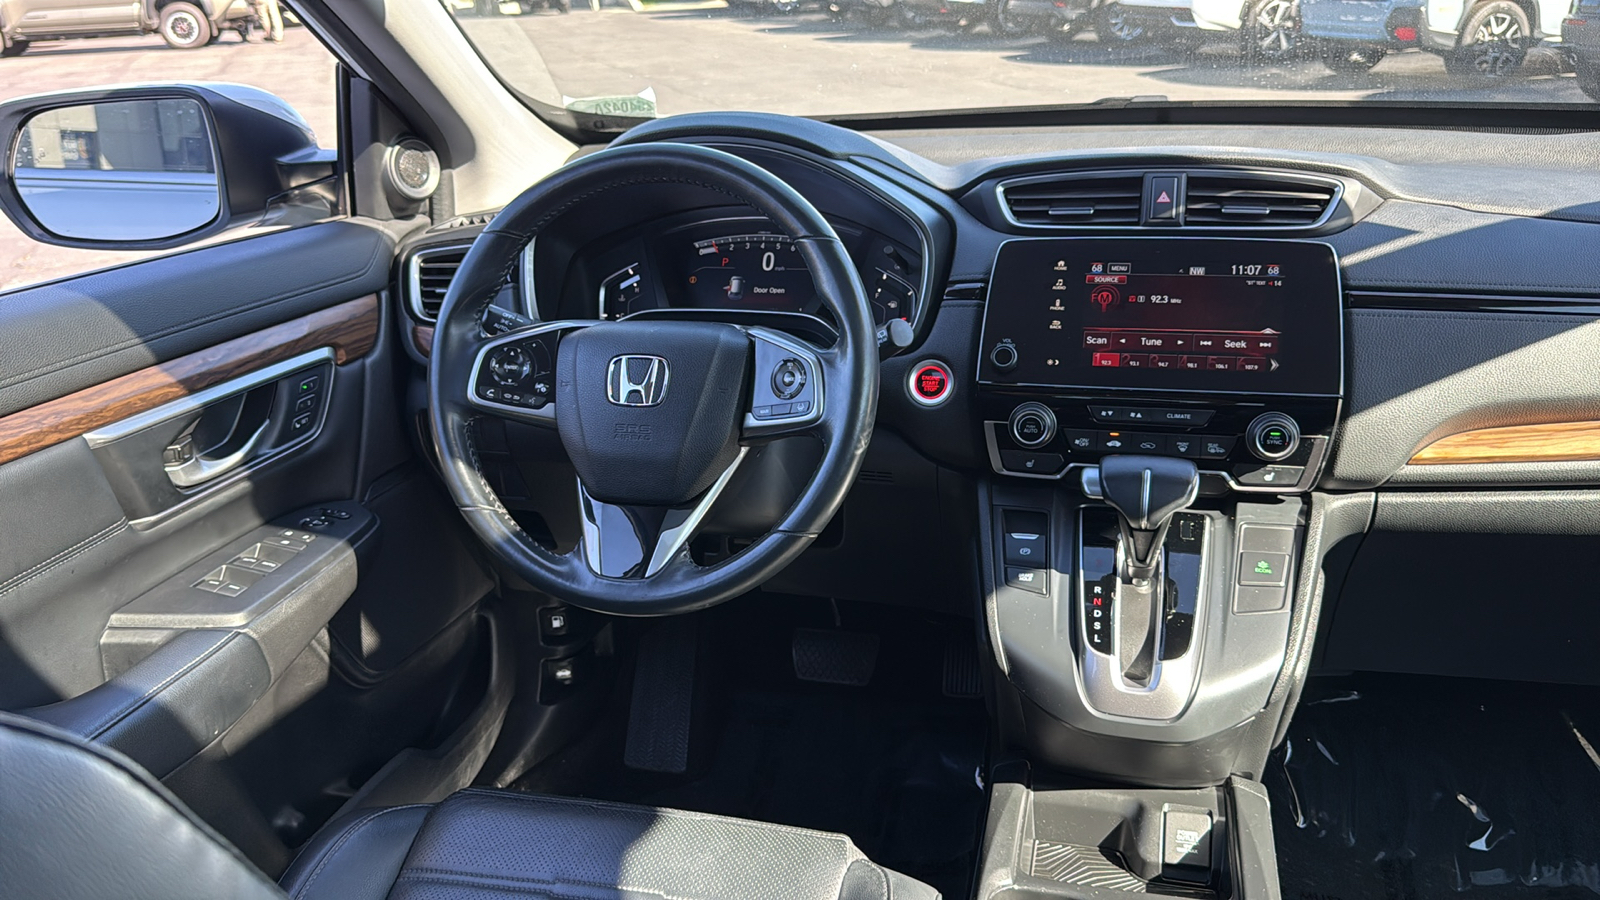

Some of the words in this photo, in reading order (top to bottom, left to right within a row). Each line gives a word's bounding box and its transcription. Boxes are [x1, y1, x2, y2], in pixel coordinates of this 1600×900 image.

[721, 257, 729, 267] P
[762, 251, 775, 272] 0
[1091, 264, 1103, 273] 68
[1190, 267, 1205, 276] NW
[1231, 264, 1262, 276] 11:07
[1267, 266, 1280, 275] 68
[753, 286, 769, 294] Door
[769, 287, 786, 295] Open
[1150, 294, 1169, 304] 92.3
[1086, 335, 1108, 345] Scan
[1140, 337, 1163, 346] Tune
[1224, 339, 1247, 349] Seek
[1166, 412, 1192, 420] CLIMATE
[614, 423, 652, 434] SRS
[1093, 585, 1102, 594] R
[1093, 597, 1102, 606] N
[1093, 609, 1102, 618] D
[1093, 621, 1102, 630] S
[1094, 634, 1102, 643] L
